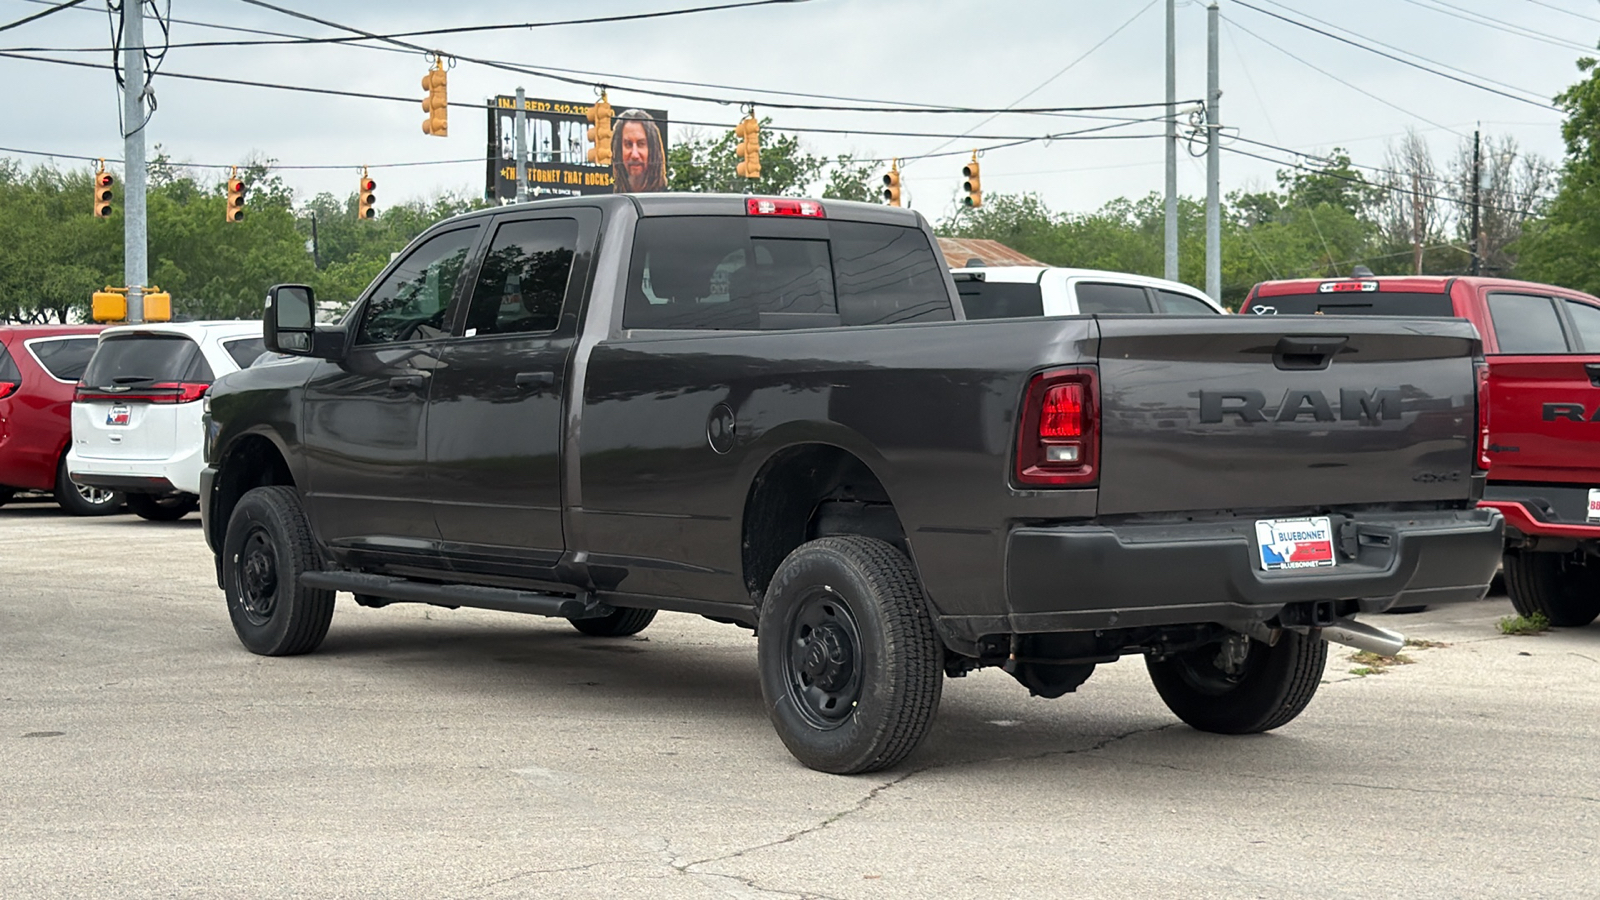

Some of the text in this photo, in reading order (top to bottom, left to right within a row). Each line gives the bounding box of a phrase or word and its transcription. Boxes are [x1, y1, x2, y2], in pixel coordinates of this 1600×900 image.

[498, 98, 551, 111] INJRED?
[501, 116, 552, 163] DVID
[527, 168, 561, 183] TTORNEY
[563, 170, 583, 185] THAT
[584, 173, 609, 187] ROCKS
[1199, 387, 1402, 424] RAM
[1278, 530, 1326, 541] BLUEBONNET
[1280, 560, 1319, 570] BLUEBONNET
